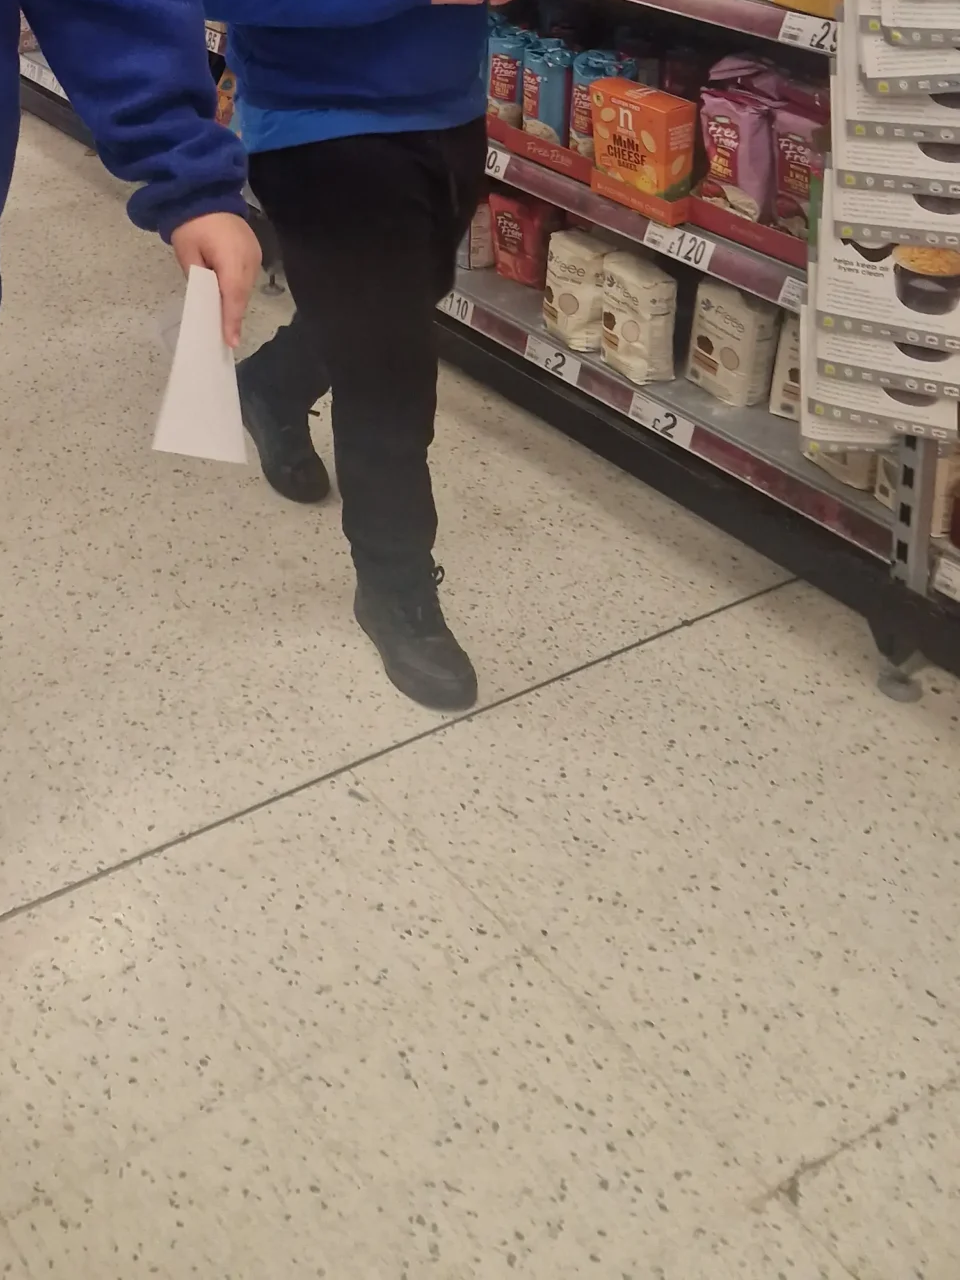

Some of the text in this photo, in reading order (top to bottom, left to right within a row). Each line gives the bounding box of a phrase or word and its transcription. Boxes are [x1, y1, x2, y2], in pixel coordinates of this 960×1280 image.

[619, 107, 633, 131] n
[708, 121, 739, 140] Free
[526, 141, 550, 158] Free
[607, 144, 647, 167] CHEESE
[486, 150, 501, 174] 0p
[497, 215, 520, 231] Free
[544, 352, 567, 377] £2
[651, 412, 678, 439] £2
